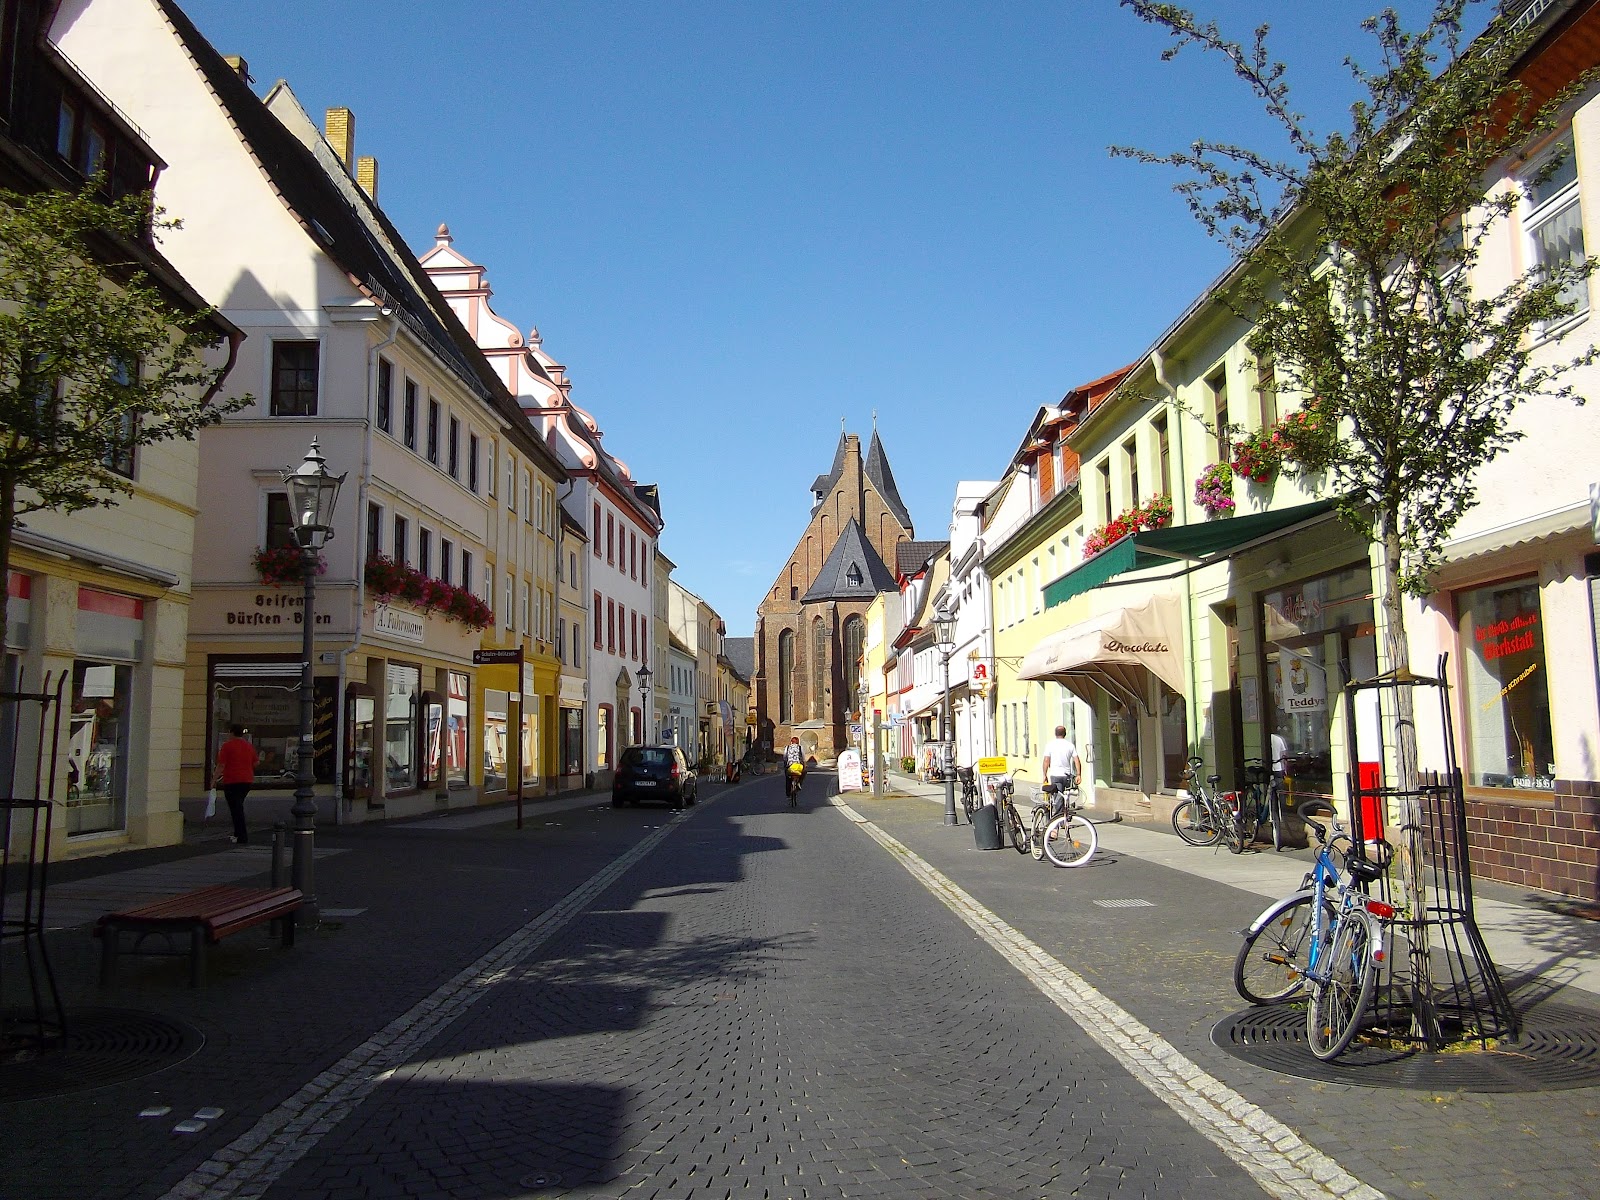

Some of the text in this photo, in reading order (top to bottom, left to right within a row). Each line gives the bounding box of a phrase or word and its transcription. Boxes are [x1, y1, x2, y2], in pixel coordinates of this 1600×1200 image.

[255, 594, 304, 608] Seifen
[387, 612, 423, 636] Fuhrmann
[1482, 630, 1536, 662] Werkstatt
[1287, 697, 1325, 708] Teddys
